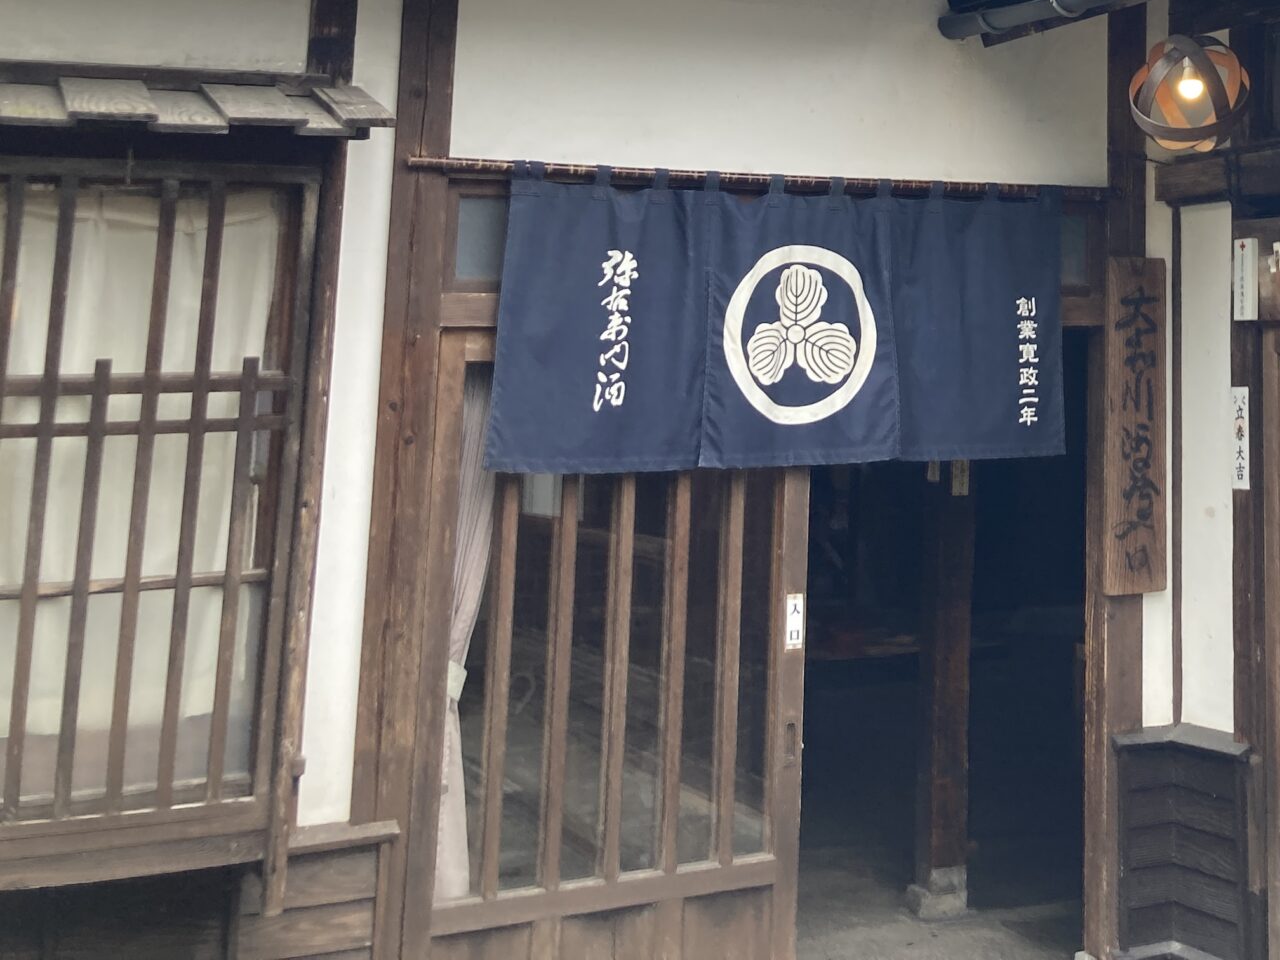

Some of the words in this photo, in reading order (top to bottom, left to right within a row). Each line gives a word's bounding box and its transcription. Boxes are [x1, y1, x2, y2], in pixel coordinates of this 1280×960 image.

[1015, 296, 1040, 427] 創業寛政二年
[1235, 405, 1246, 481] 立春大吉
[789, 603, 801, 641] 入口
